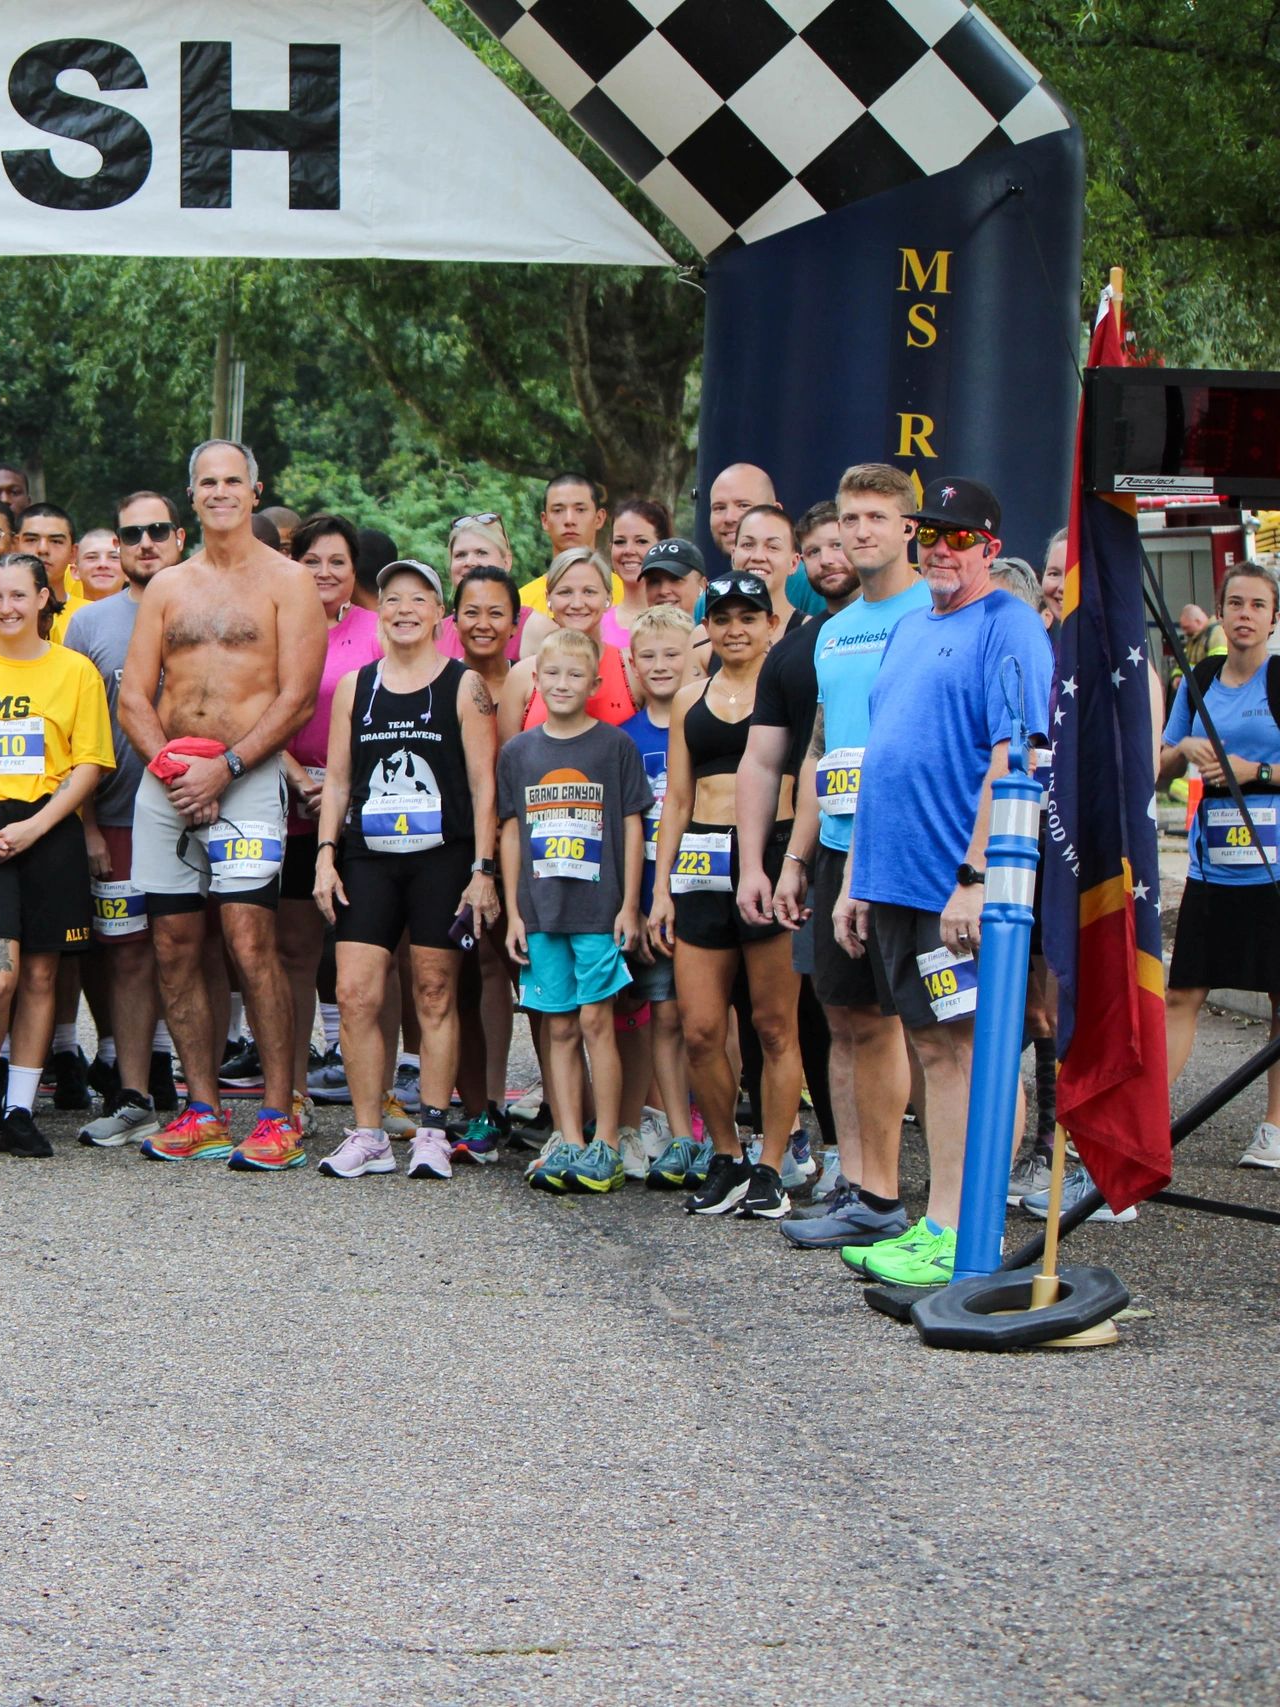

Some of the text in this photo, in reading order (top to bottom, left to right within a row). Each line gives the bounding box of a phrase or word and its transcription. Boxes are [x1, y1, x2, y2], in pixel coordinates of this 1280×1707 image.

[1116, 476, 1176, 487] Raceclock
[649, 543, 679, 556] CVG
[1224, 551, 1234, 566] E
[836, 627, 887, 646] Hattiesb
[388, 720, 414, 729] TEAM
[361, 730, 442, 742] DRAGON SLAYERS
[826, 768, 861, 795] 203
[529, 785, 601, 803] GRAND CANYON
[394, 813, 409, 835] 4
[525, 808, 603, 824] NATIONAL PARK
[1047, 800, 1067, 843] GOD
[1225, 826, 1251, 847] 48
[223, 838, 263, 860] 198
[545, 836, 585, 860] 206
[676, 851, 711, 875] 223
[94, 898, 129, 919] 162
[65, 928, 83, 941] ALL
[924, 969, 958, 1000] 149
